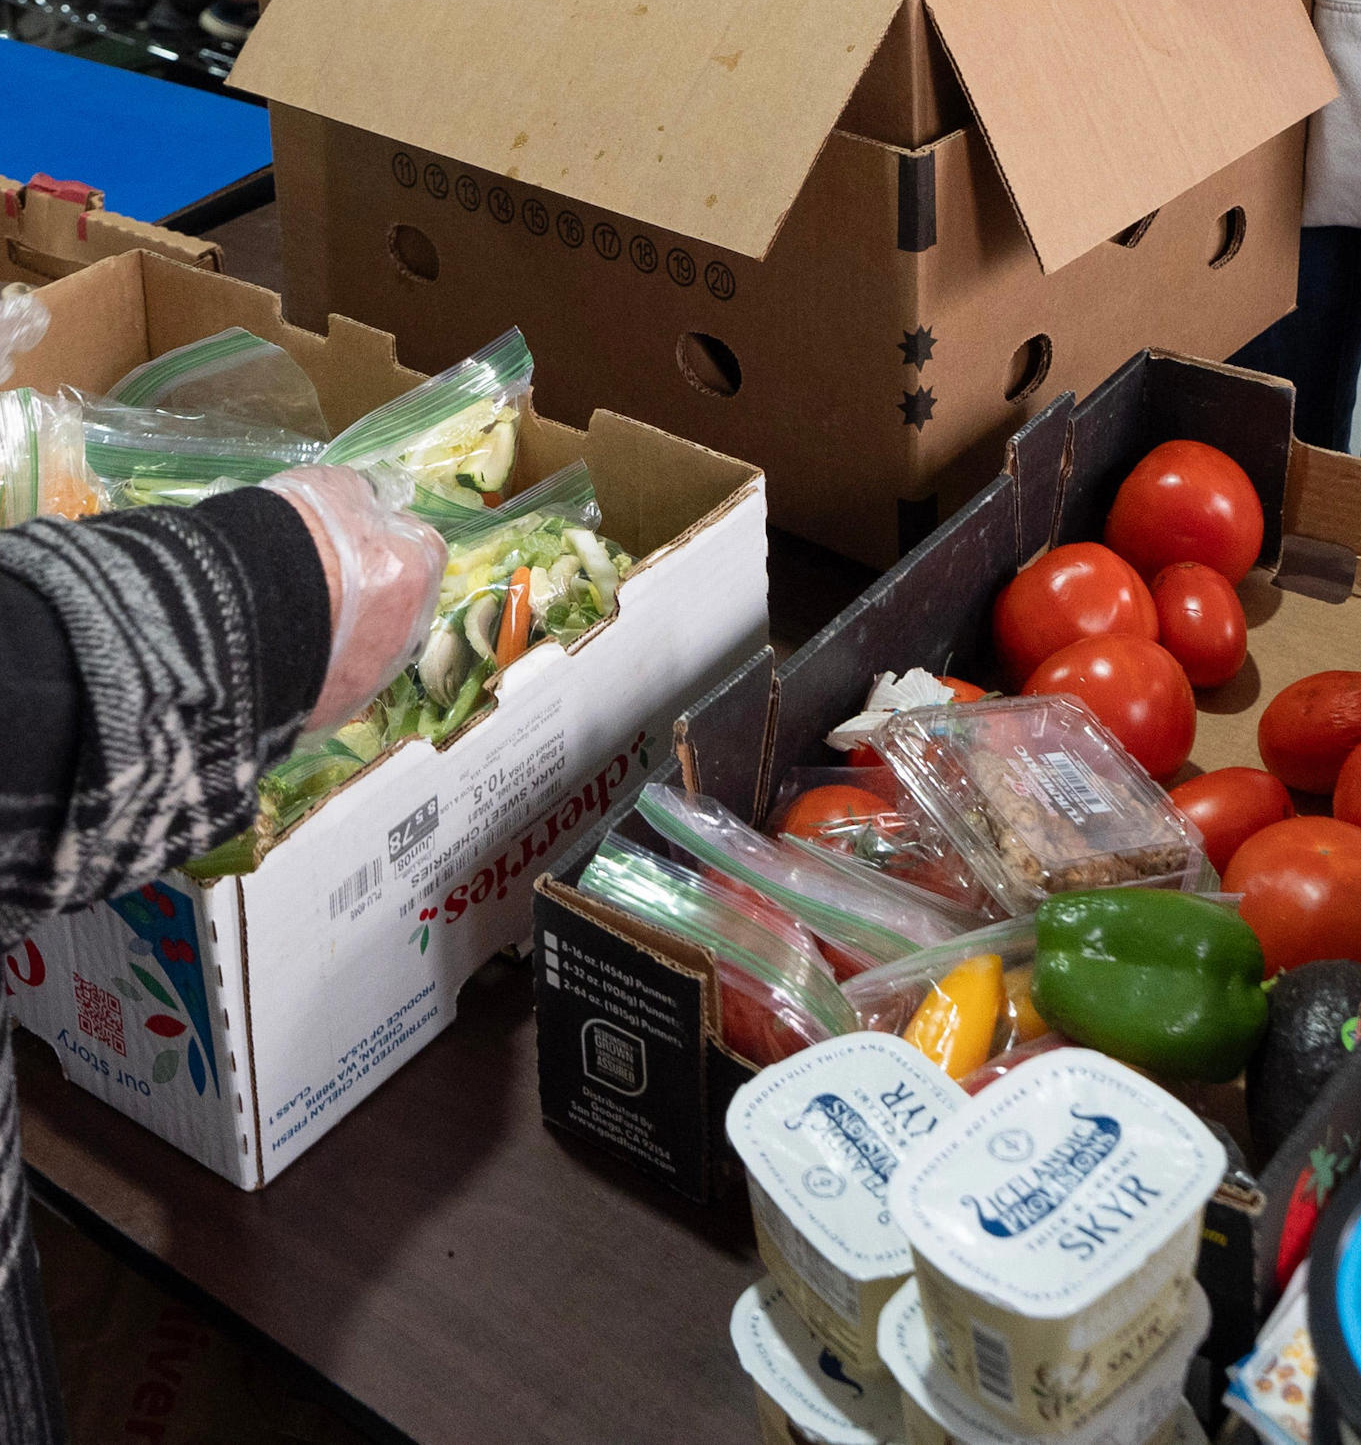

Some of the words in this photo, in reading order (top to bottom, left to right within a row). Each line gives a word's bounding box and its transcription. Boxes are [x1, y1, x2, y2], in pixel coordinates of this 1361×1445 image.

[473, 768, 506, 805] 10.5
[507, 762, 527, 780] USA
[532, 756, 566, 786] DARK
[1013, 744, 1086, 826] TURMERIC
[415, 810, 425, 824] 5
[428, 799, 437, 815] 8
[484, 787, 528, 829] SWEET
[389, 821, 414, 854] 78
[397, 835, 433, 872] Jun08
[444, 753, 632, 924] cherries
[410, 826, 481, 888] CHERRIES
[561, 941, 583, 960] 8-16
[562, 959, 585, 980] 4-32
[386, 980, 436, 1027] PRODUCE
[563, 979, 587, 1000] 2-64
[641, 1019, 684, 1050] Punnets
[358, 1022, 404, 1061] CHELAN,
[370, 1024, 385, 1041] OF
[372, 1006, 439, 1066] DISTRIBUTED
[594, 1035, 634, 1065] GROWN
[57, 1028, 110, 1076] story
[338, 1038, 369, 1065] U.S.A.
[116, 1068, 152, 1096] our
[337, 1062, 358, 1081] WA
[355, 1065, 370, 1081] BY
[596, 1055, 636, 1084] ASSURED
[276, 1086, 312, 1118] CLASS
[305, 1078, 336, 1110] 98816
[310, 1079, 354, 1119] CHELAN
[880, 1080, 938, 1139] YR
[272, 1116, 308, 1151] FRESH
[571, 1101, 590, 1117] San
[625, 1125, 640, 1141] CA
[984, 1123, 1096, 1216] ICELANDIC
[1058, 1174, 1162, 1261] SKYR
